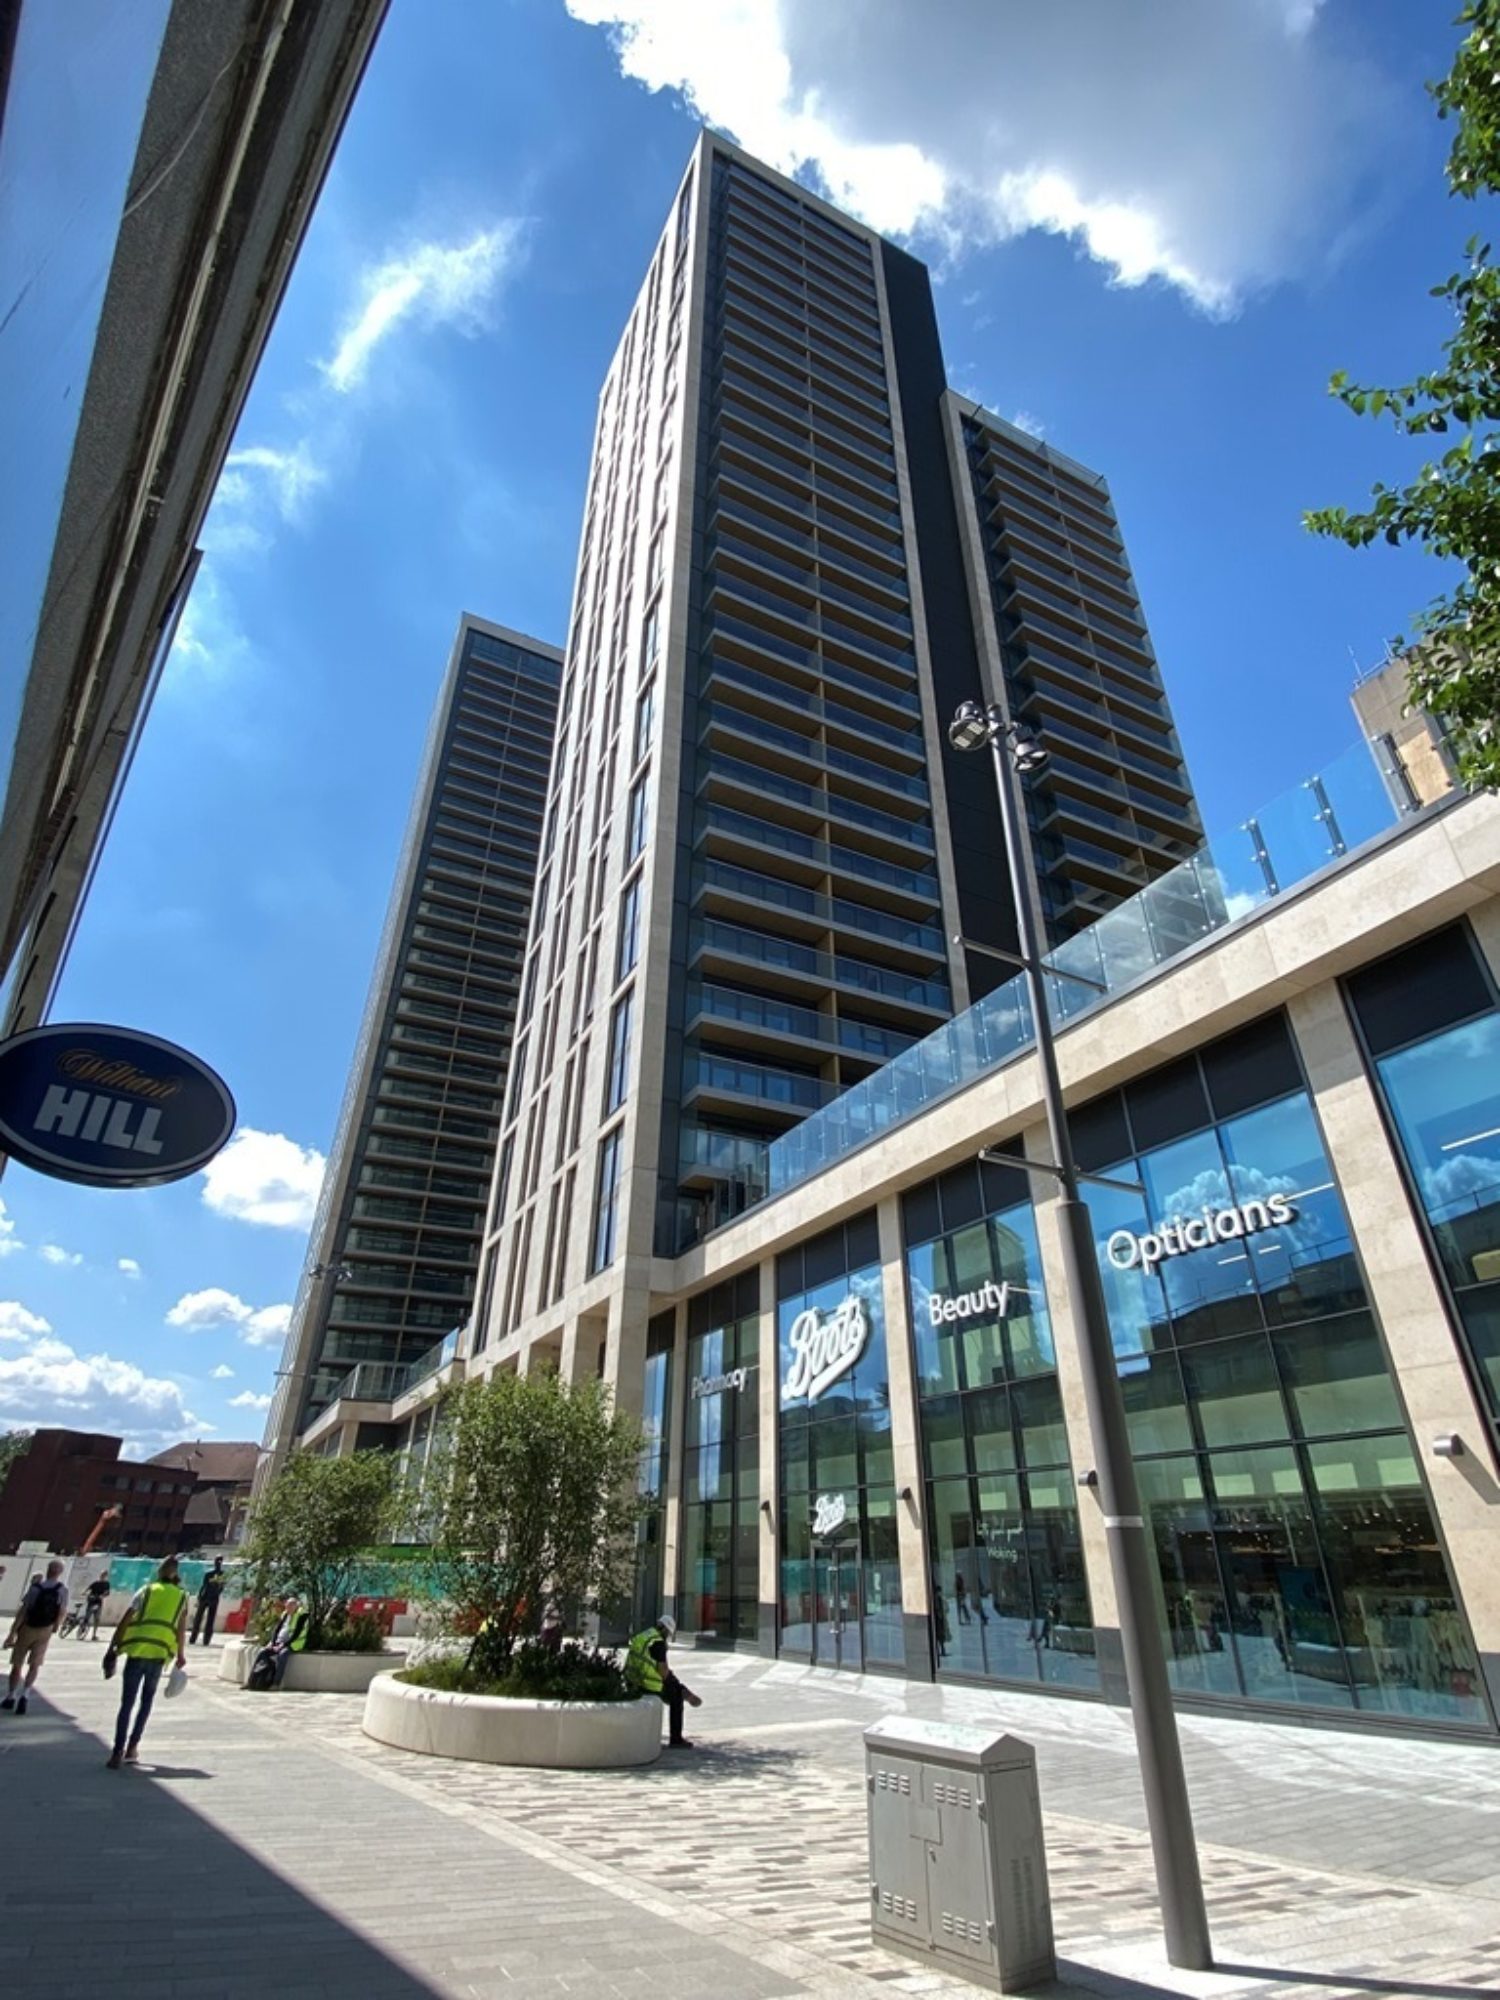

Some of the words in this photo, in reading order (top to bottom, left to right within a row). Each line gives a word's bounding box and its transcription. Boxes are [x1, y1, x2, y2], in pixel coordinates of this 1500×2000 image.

[33, 1083, 164, 1155] HILL
[1107, 1193, 1293, 1276] Opticians
[929, 1280, 1008, 1327] Beauty
[781, 1294, 868, 1407] Boots
[691, 1367, 747, 1400] Pharmacy
[812, 1493, 846, 1536] Boots
